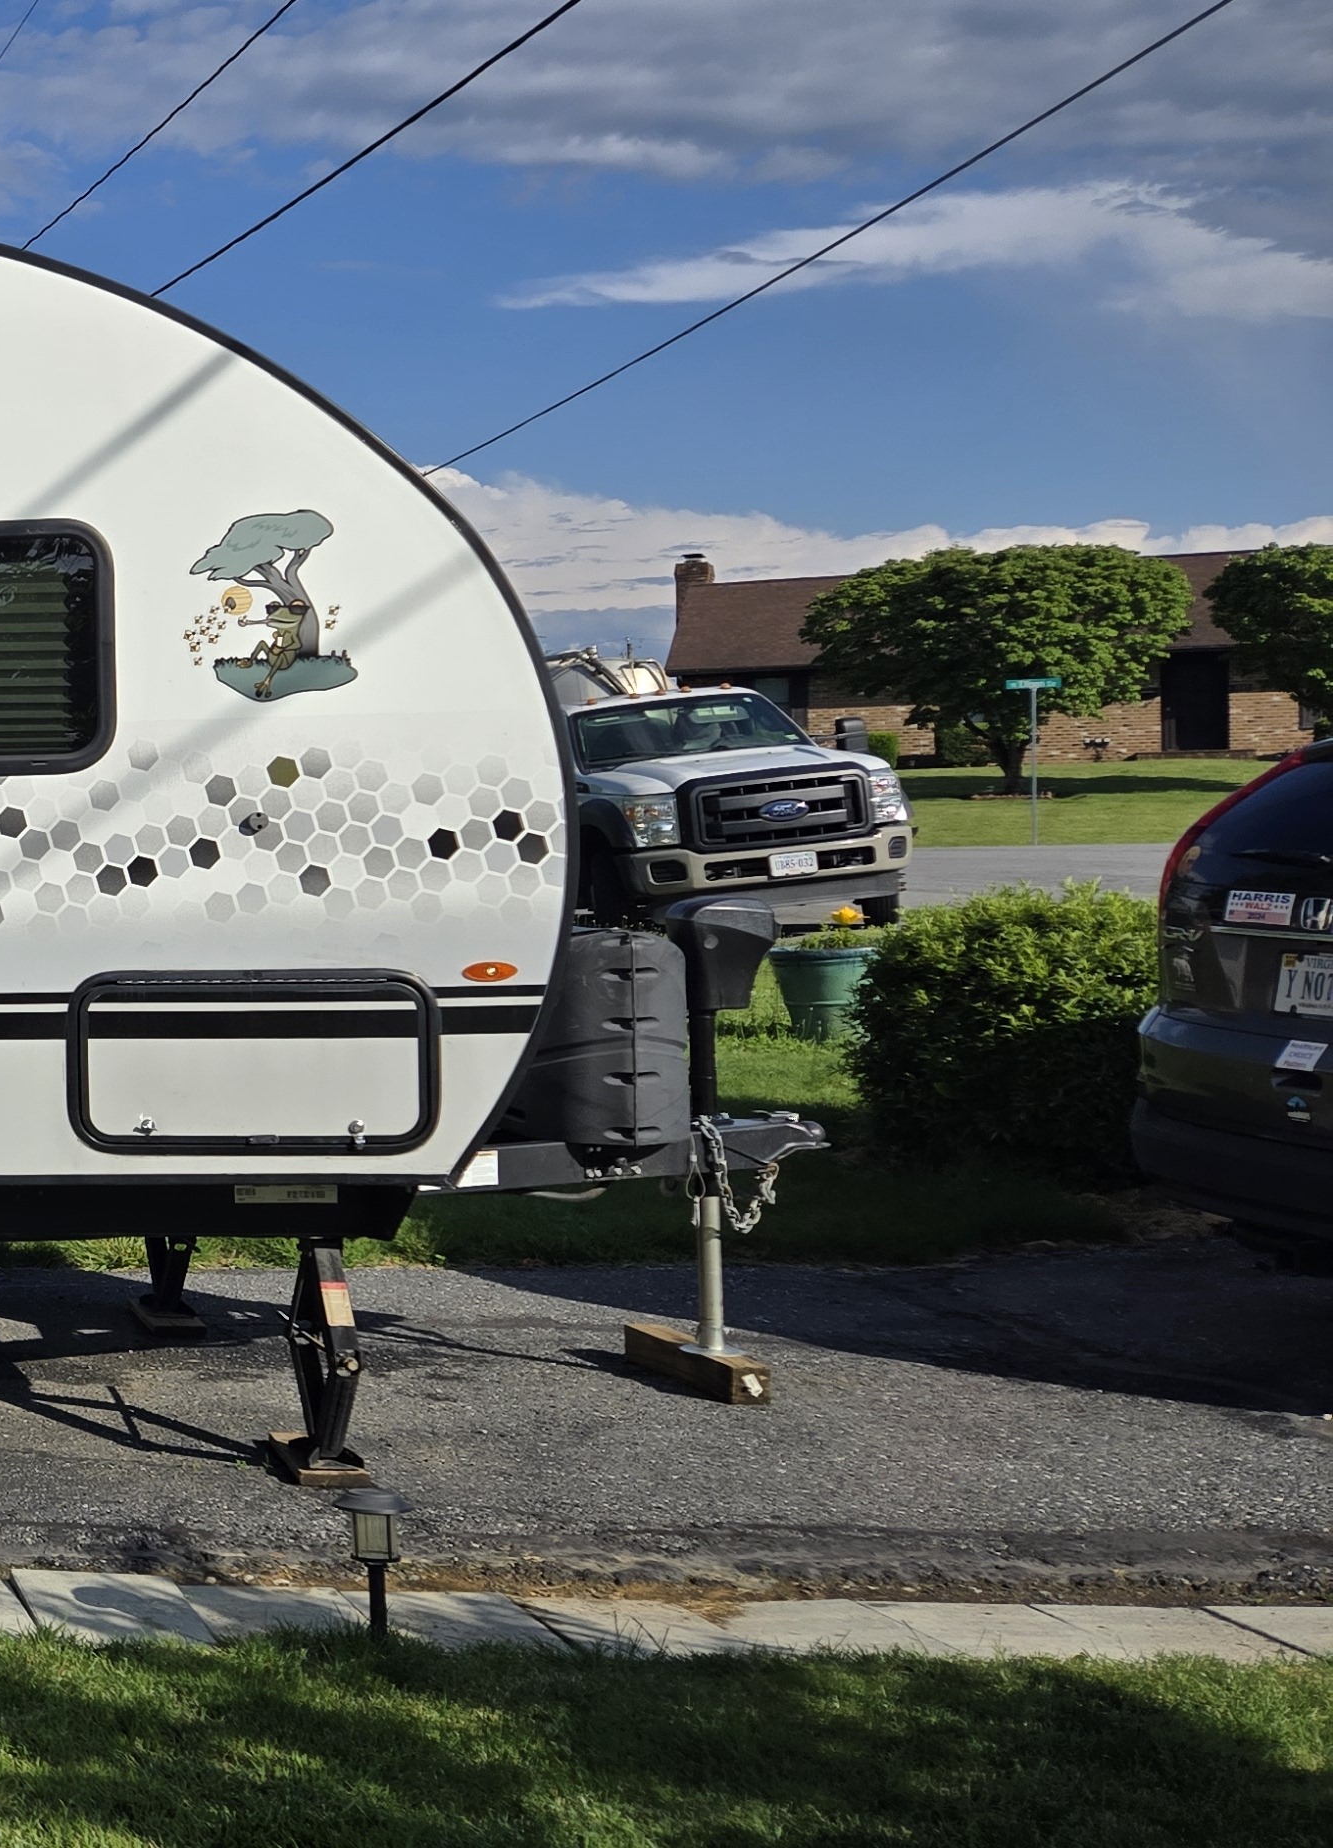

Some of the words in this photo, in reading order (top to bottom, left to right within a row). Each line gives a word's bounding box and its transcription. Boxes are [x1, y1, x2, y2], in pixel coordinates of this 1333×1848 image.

[1233, 892, 1291, 904] HARRIS
[1245, 901, 1272, 911] WALZ
[1286, 969, 1298, 998] Y
